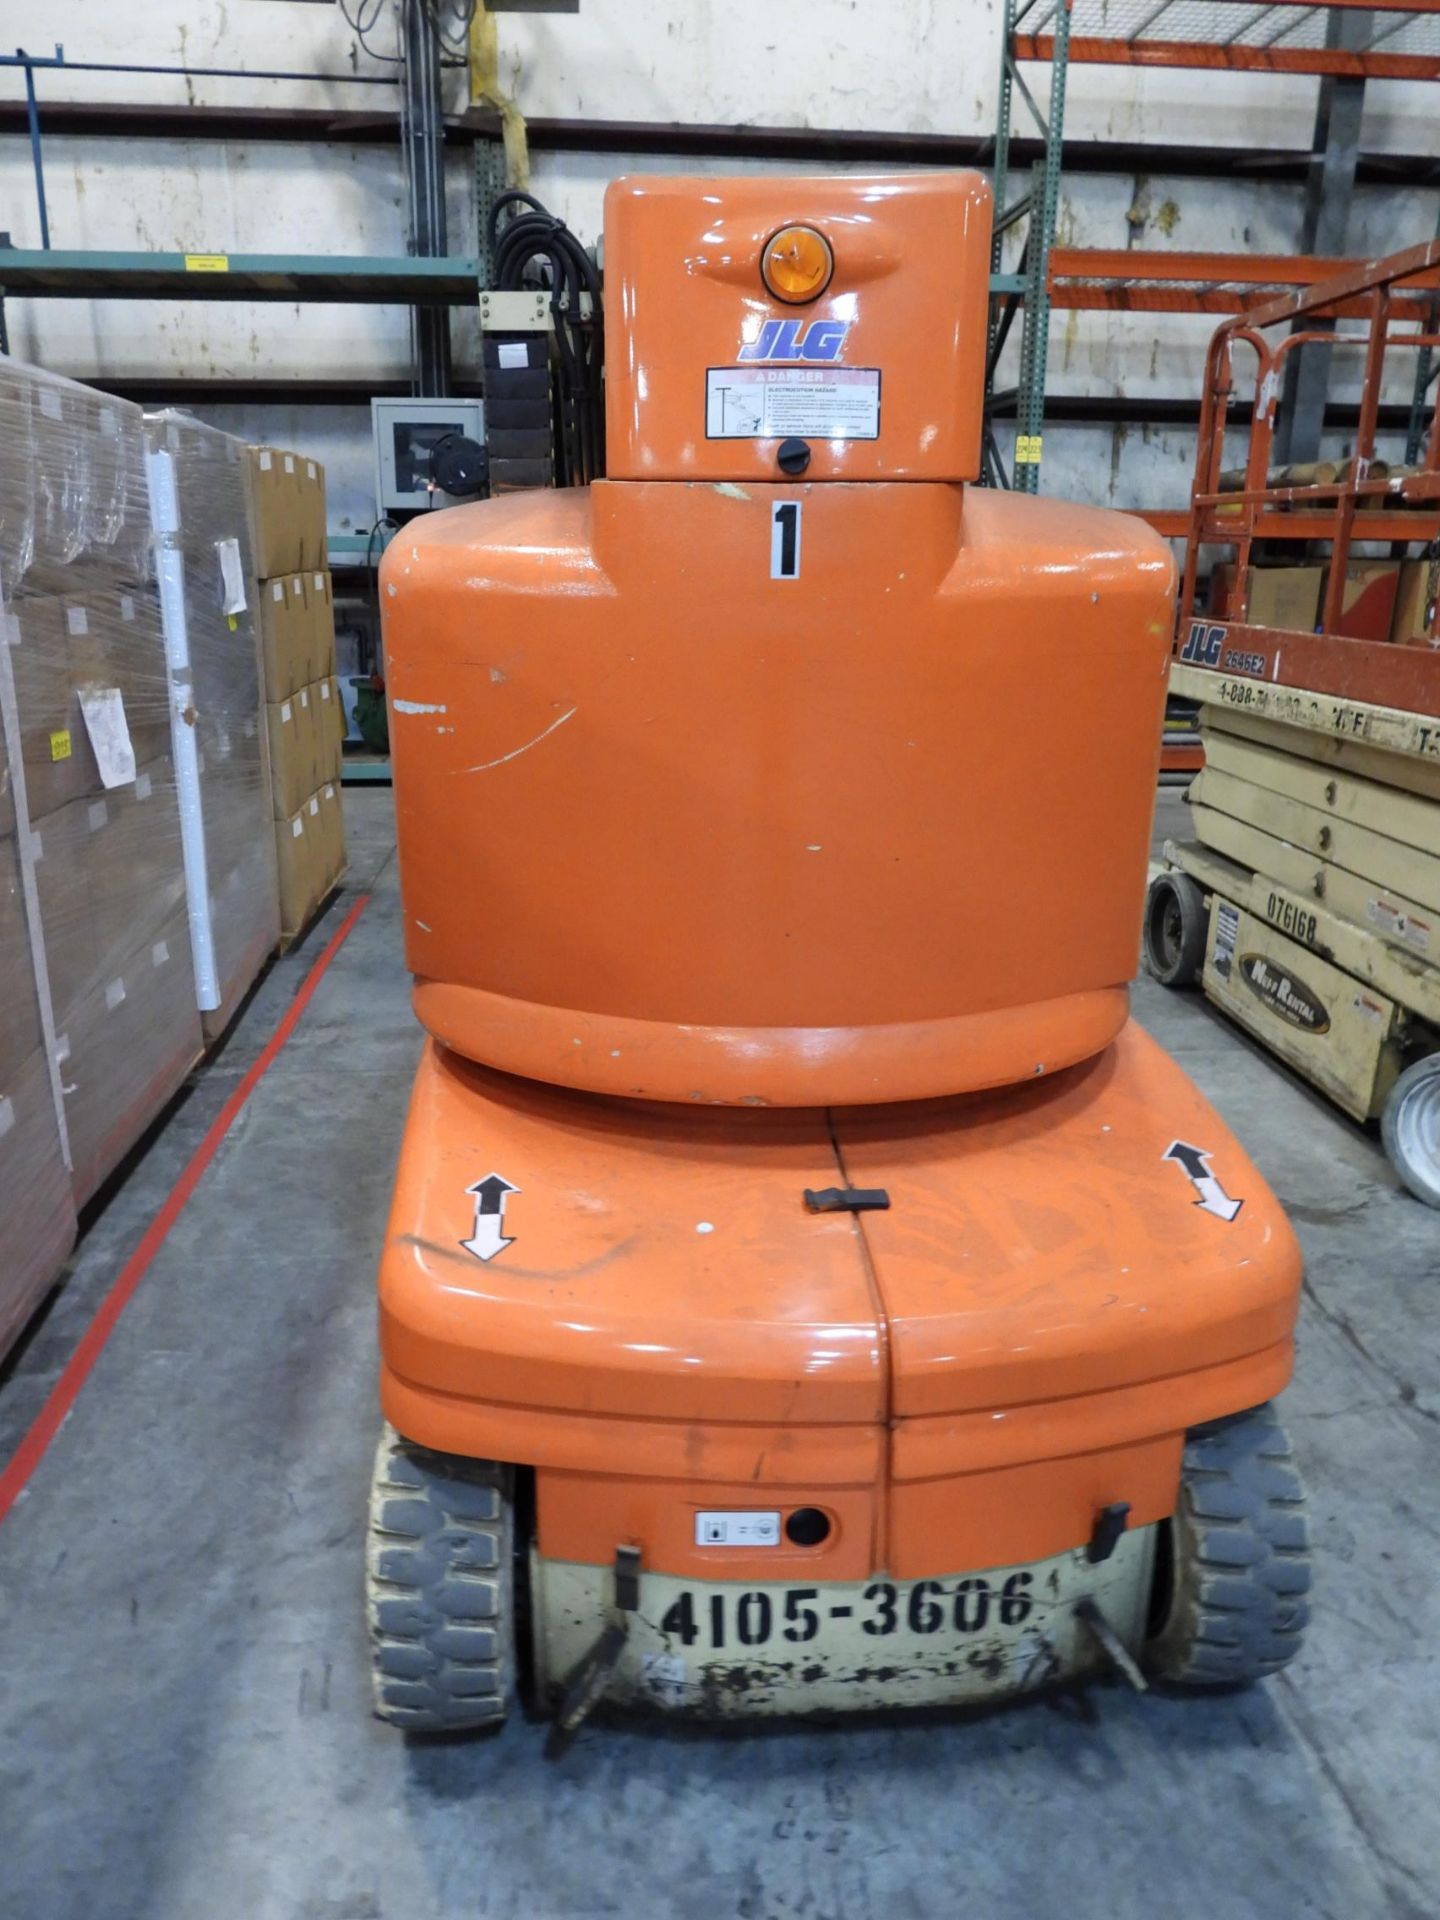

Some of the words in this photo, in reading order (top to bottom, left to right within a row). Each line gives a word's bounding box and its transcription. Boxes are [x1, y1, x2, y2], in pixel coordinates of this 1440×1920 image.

[737, 319, 849, 361] JLG
[767, 371, 824, 383] DANGER
[775, 504, 797, 575] 1
[1181, 623, 1227, 667] JLG
[1224, 649, 1265, 675] 2646E2
[1267, 892, 1317, 945] 076168
[661, 1571, 1034, 1649] 4105-3606
